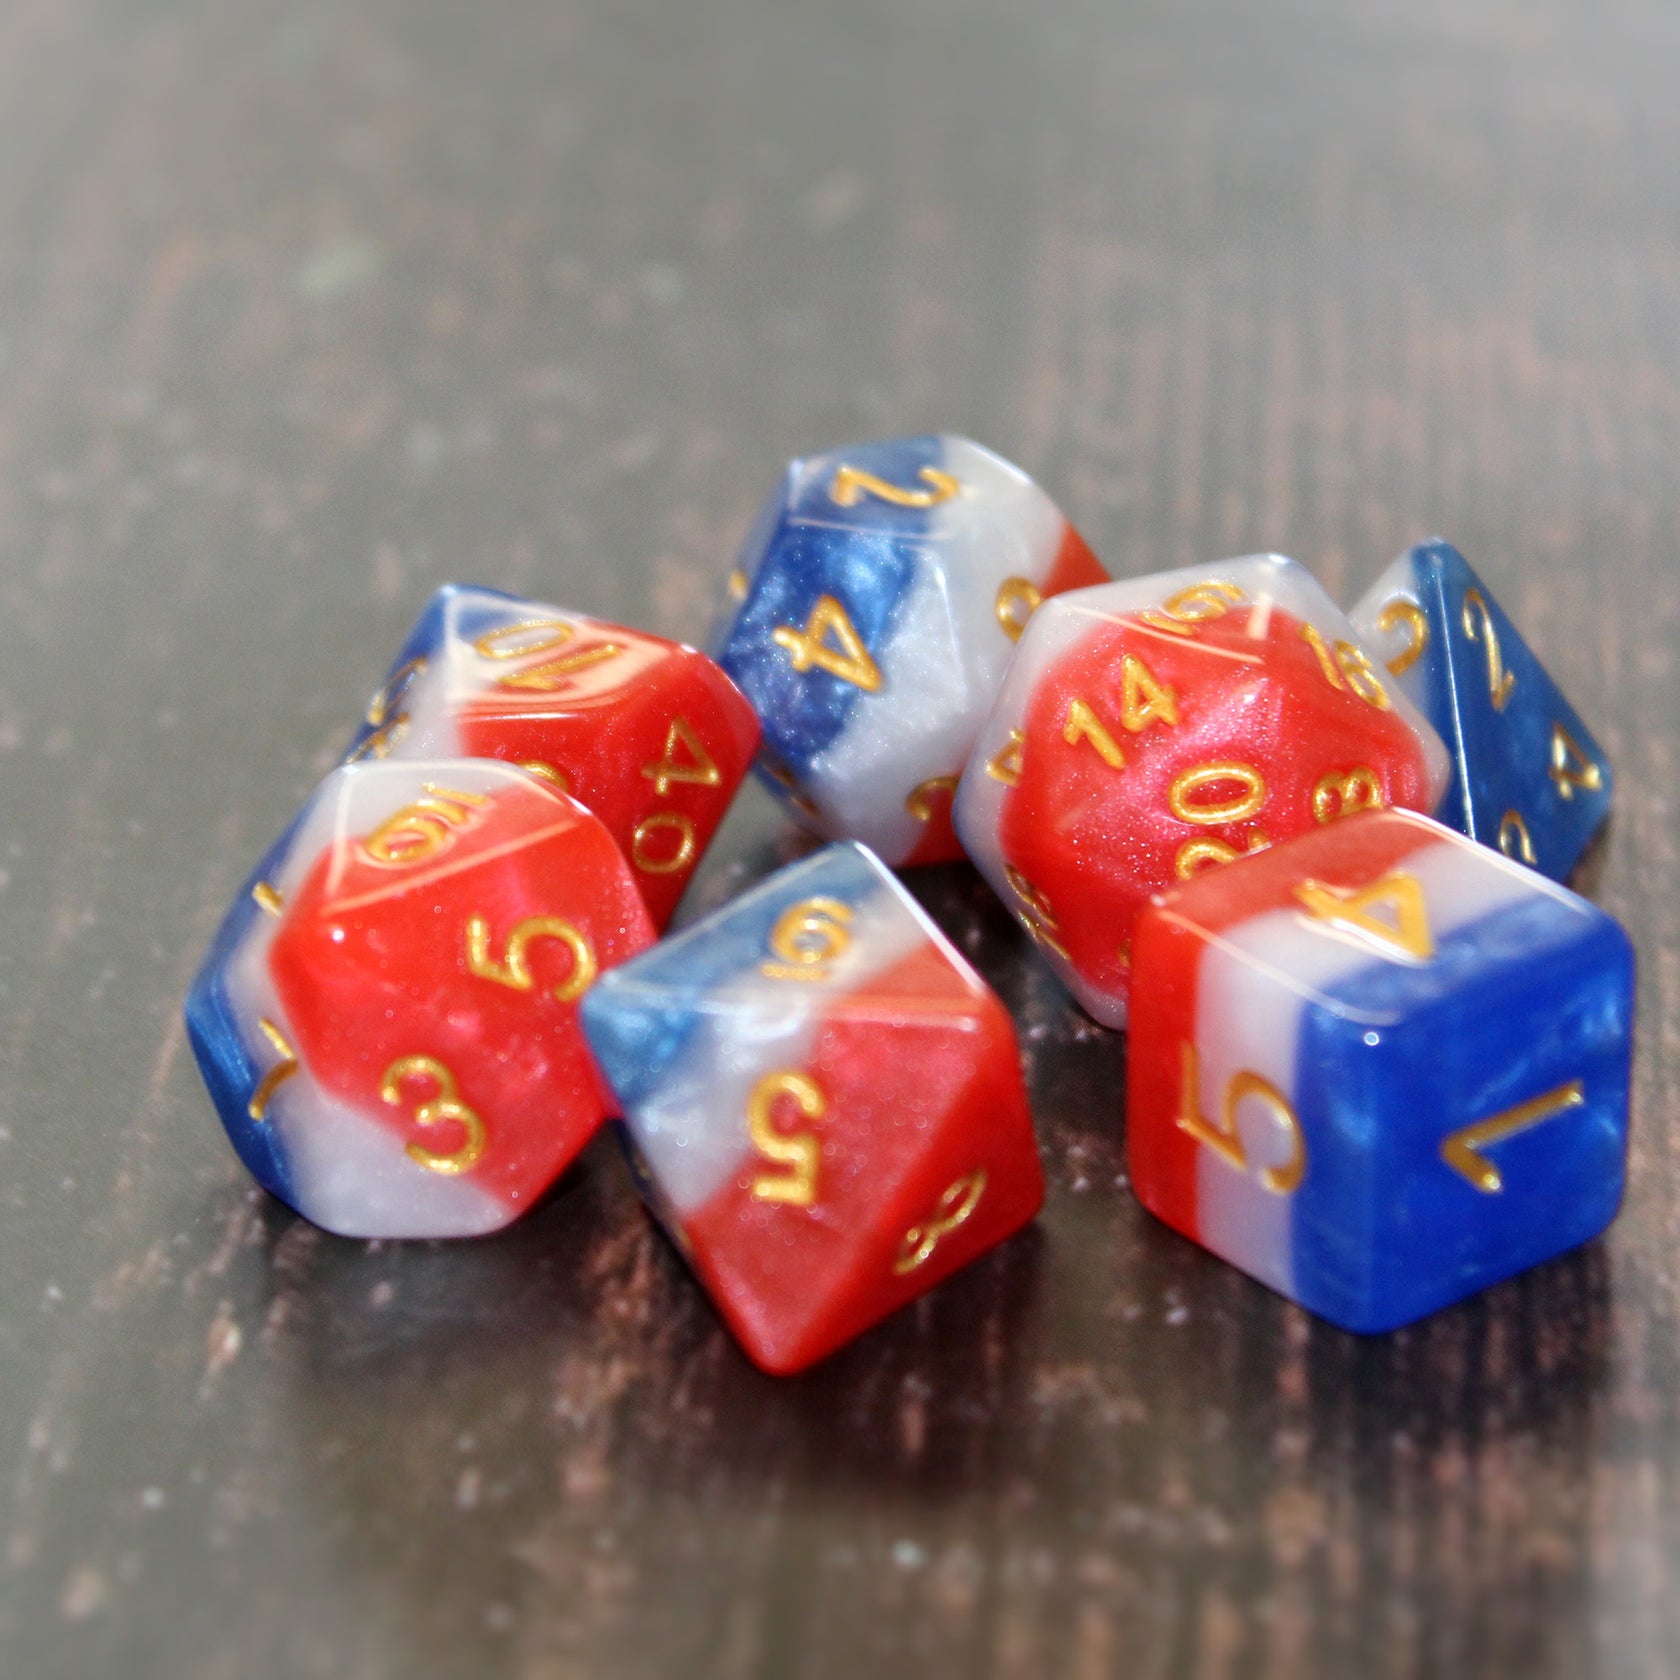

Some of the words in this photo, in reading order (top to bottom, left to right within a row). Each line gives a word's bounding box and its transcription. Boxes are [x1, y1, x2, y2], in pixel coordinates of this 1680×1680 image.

[832, 464, 960, 507] 2
[772, 594, 884, 692] 4
[1062, 653, 1182, 770] 14
[1548, 722, 1603, 801] 4
[631, 715, 722, 875] 40
[467, 915, 597, 1002] 5
[1292, 869, 1437, 964] 4
[381, 1055, 487, 1176] 3
[747, 1072, 826, 1206] 5
[1176, 1042, 1308, 1196] 5
[1439, 1080, 1585, 1195] 1
